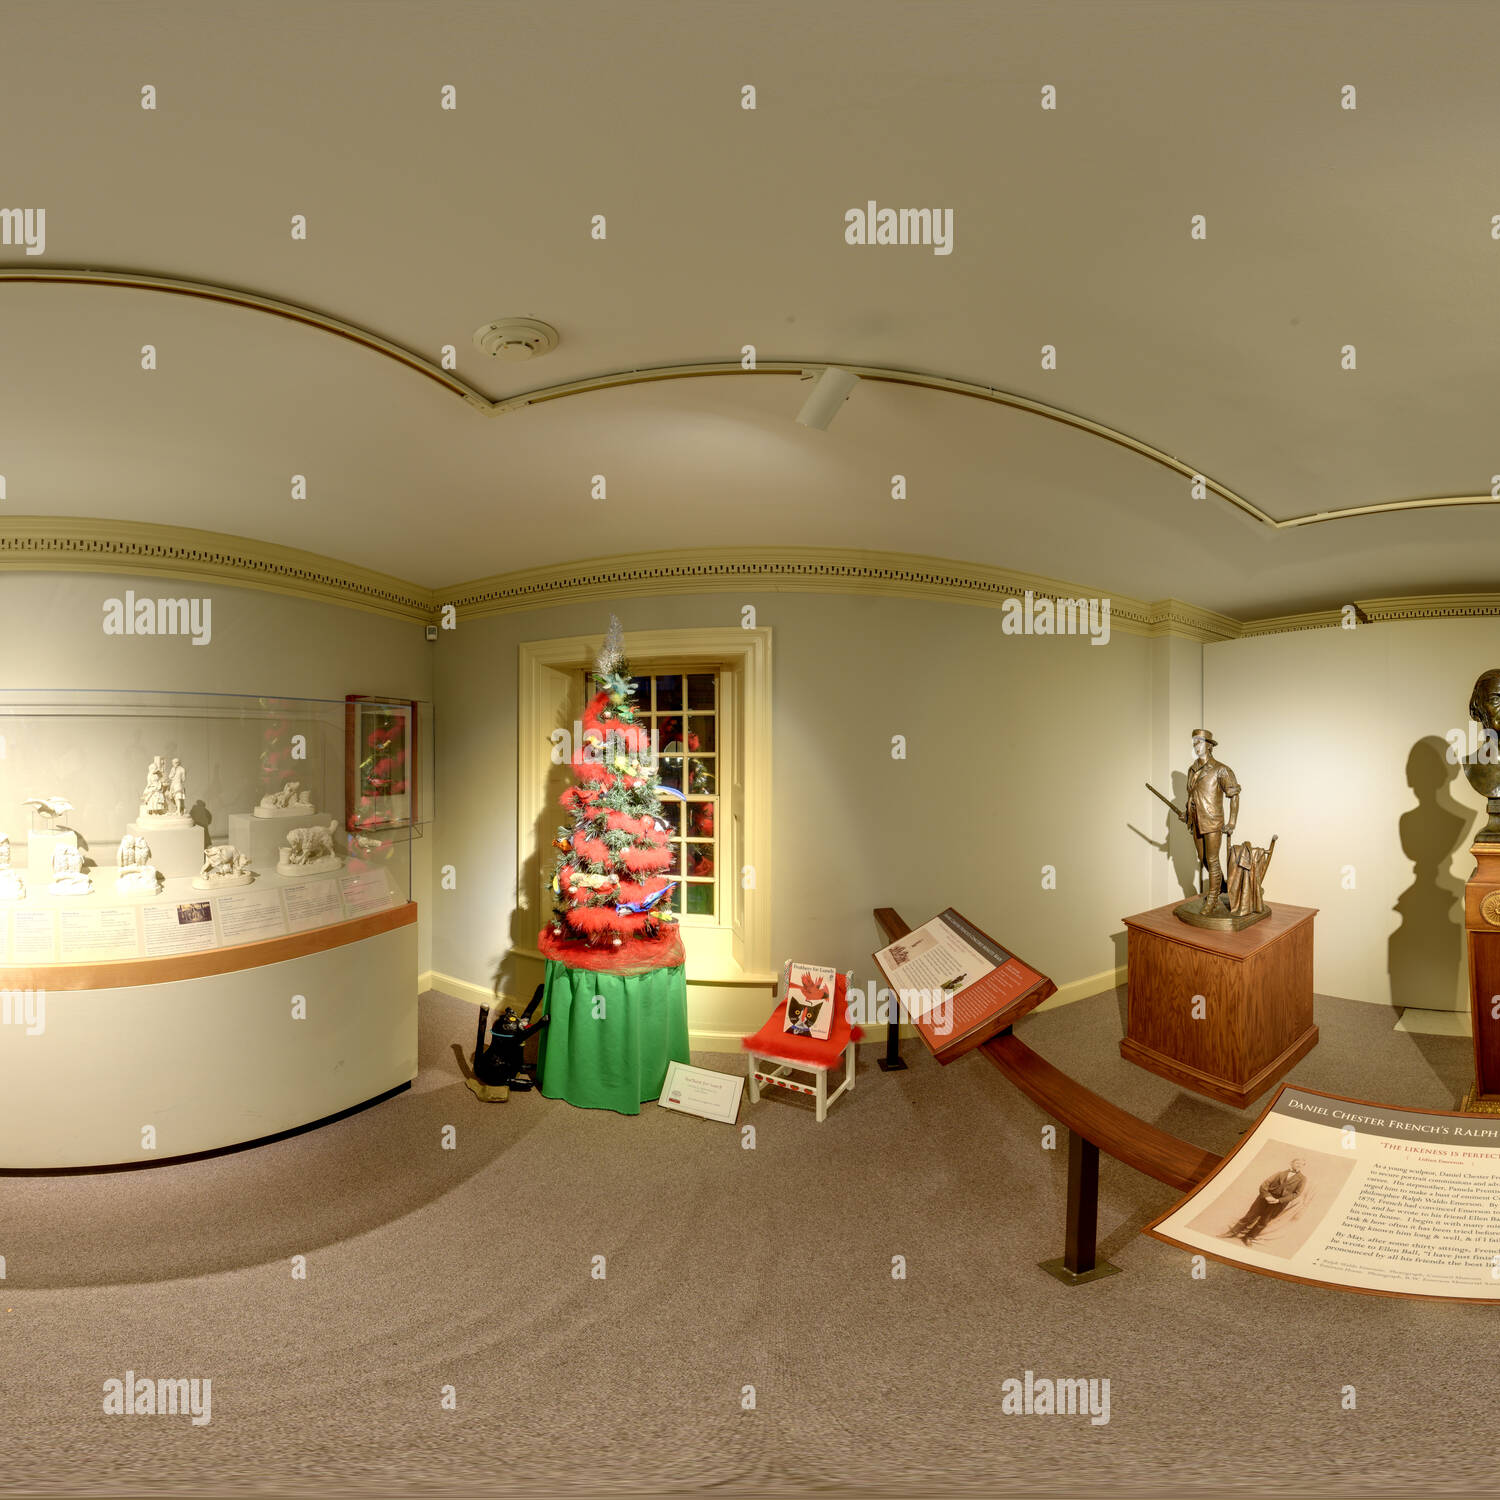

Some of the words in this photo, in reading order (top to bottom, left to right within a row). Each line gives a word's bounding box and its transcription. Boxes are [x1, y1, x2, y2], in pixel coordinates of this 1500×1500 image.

[1288, 1099, 1329, 1115] DANIEL
[1332, 1110, 1385, 1127] CHESTER
[1388, 1120, 1450, 1135] FRENCH'S
[1454, 1126, 1499, 1138] RALPH
[1404, 1146, 1448, 1156] LIKENESS
